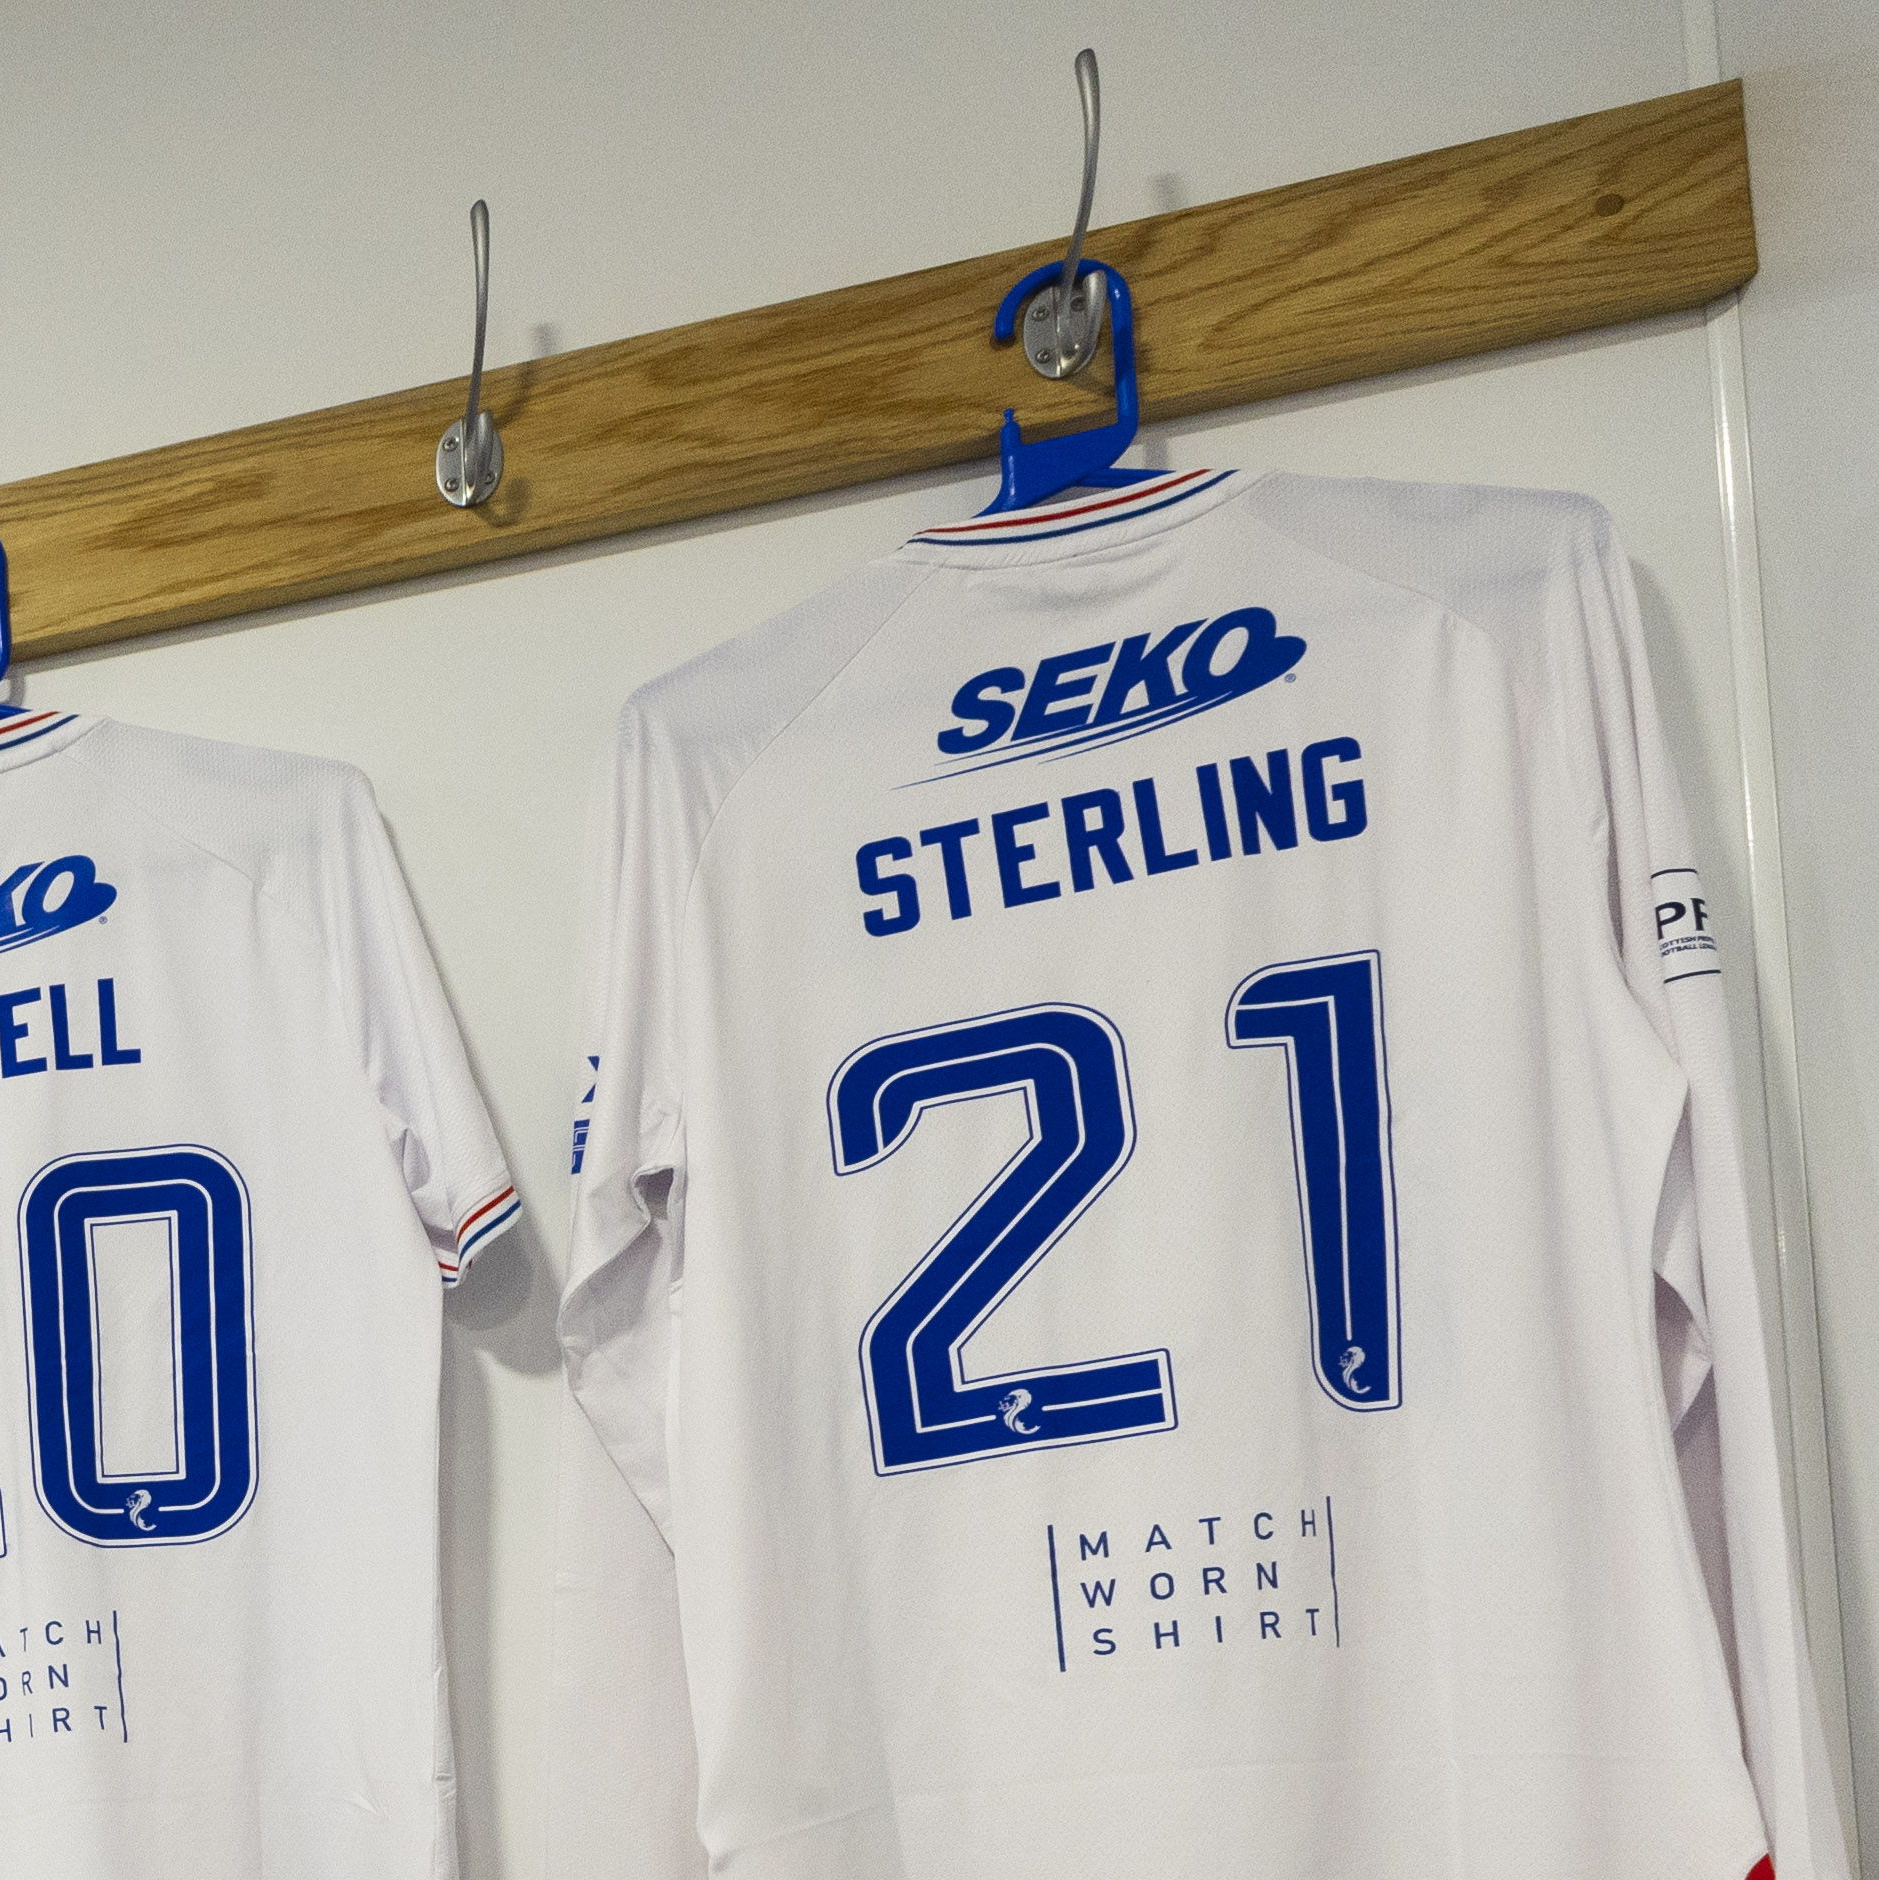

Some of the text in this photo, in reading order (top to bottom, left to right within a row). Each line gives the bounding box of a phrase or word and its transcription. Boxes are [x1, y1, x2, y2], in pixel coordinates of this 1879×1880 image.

[934, 606, 1309, 758] SEKO
[854, 736, 1369, 939] STERLING
[1655, 898, 1708, 940] PF
[827, 949, 1402, 1478] 21
[1081, 1509, 1320, 1562] MATCH
[1080, 1561, 1280, 1610] WORN
[1091, 1607, 1323, 1656] SHIRT
